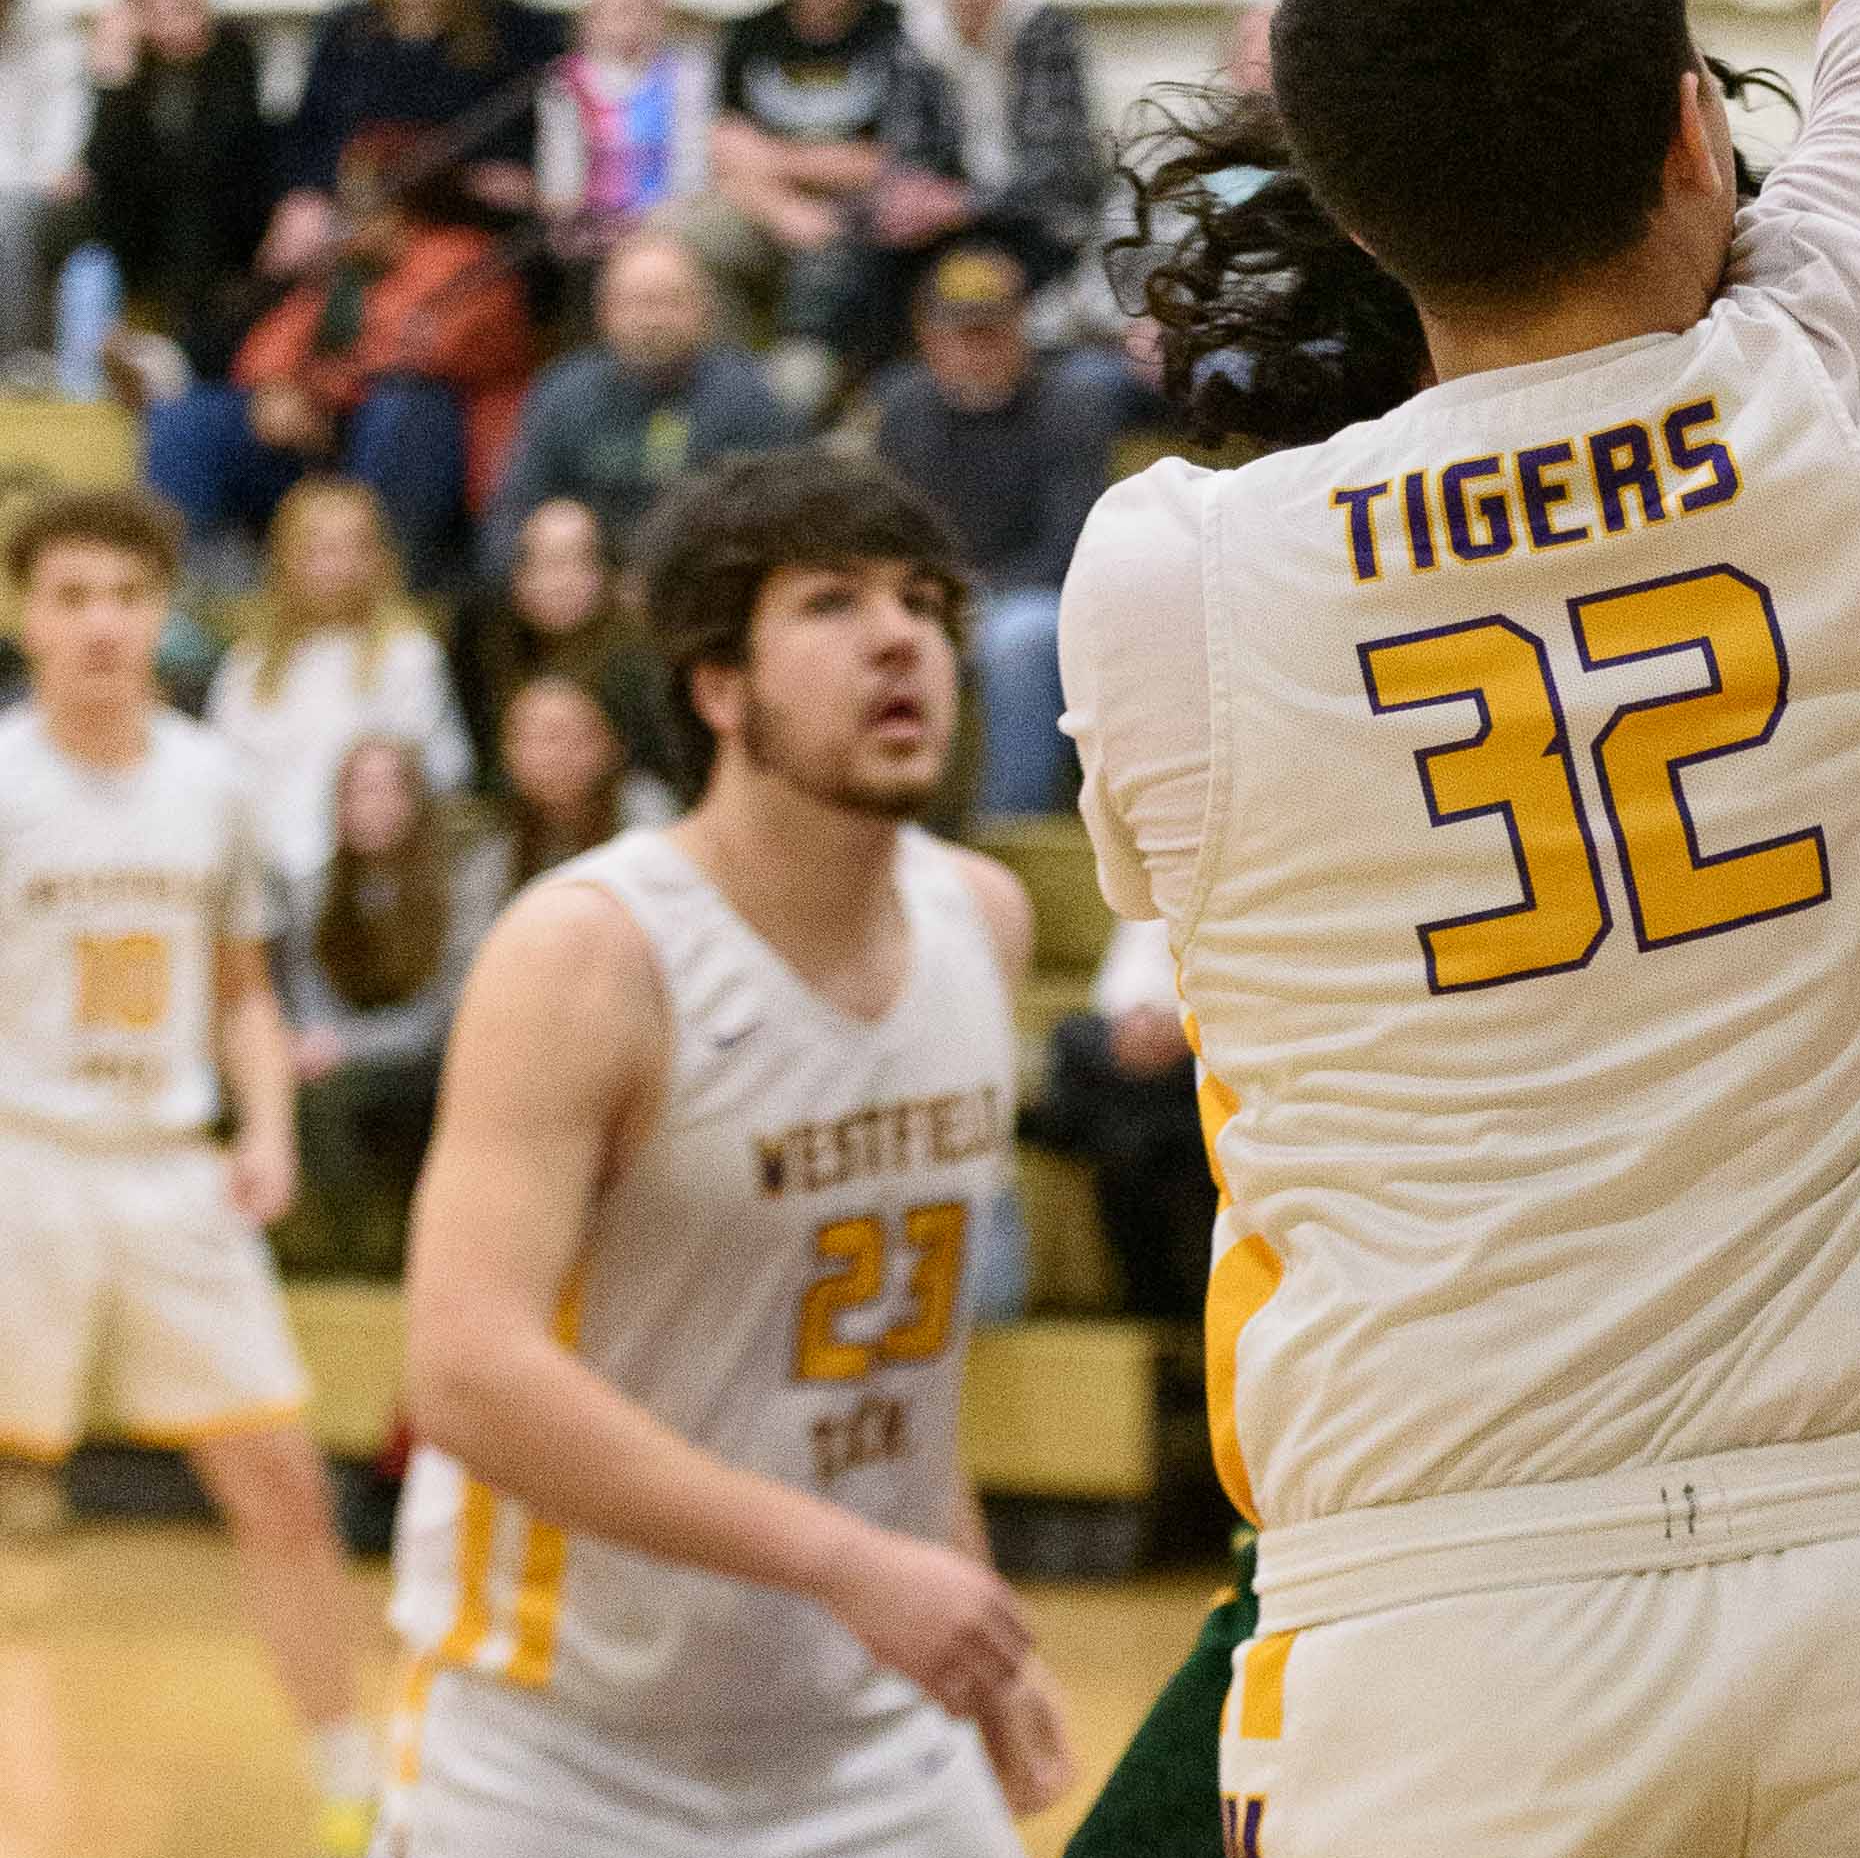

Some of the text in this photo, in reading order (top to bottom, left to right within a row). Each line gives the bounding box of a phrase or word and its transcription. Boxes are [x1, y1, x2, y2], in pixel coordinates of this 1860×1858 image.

[1330, 396, 1745, 584] TIGERS
[1356, 563, 1832, 995] 32
[790, 1196, 971, 1386] 23
